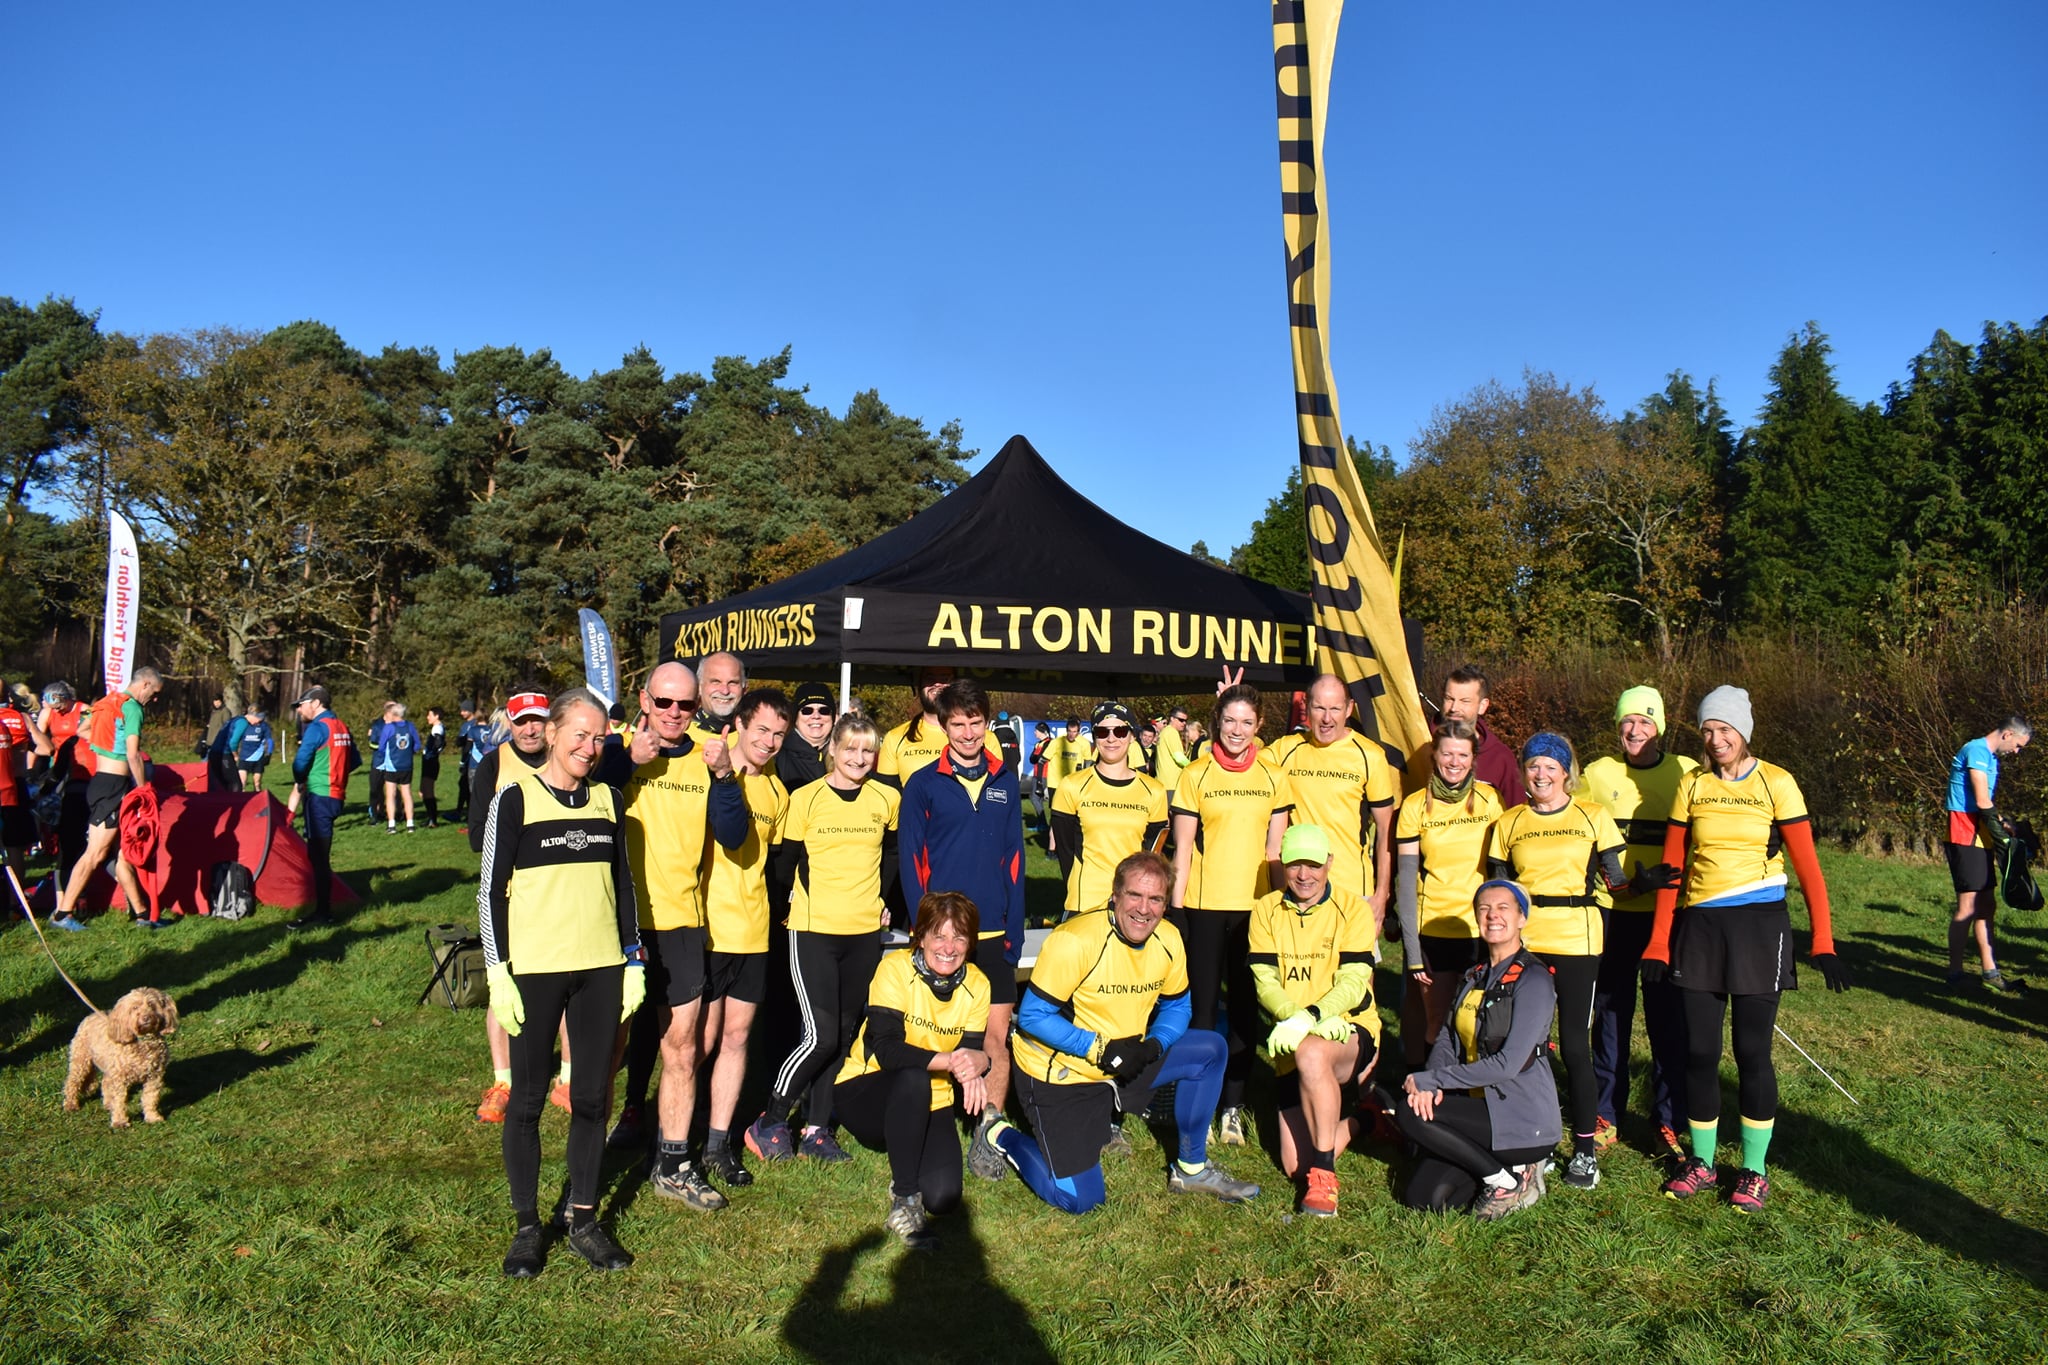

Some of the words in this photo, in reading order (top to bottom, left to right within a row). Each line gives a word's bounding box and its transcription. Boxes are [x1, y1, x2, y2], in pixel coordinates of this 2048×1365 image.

[674, 616, 722, 659] ALTON
[726, 603, 817, 652] RUNNERS
[928, 602, 1112, 654] ALTON
[903, 749, 932, 757] ALTON
[1287, 768, 1314, 778] ALTON
[1316, 769, 1361, 783] RUNNERS
[657, 780, 705, 794] RUNNERS
[1204, 789, 1232, 799] ALTON
[1234, 790, 1272, 798] RUNNERS
[1081, 800, 1109, 809] ALTON
[1111, 802, 1150, 813] RUNNERS
[1691, 797, 1719, 806] ALTON
[1448, 815, 1489, 826] RUNNERS
[1515, 831, 1540, 841] ALTON
[1542, 829, 1587, 838] RUNNERS
[540, 836, 567, 848] ALTON
[1097, 984, 1129, 994] ALTON
[904, 1011, 929, 1028] LTON
